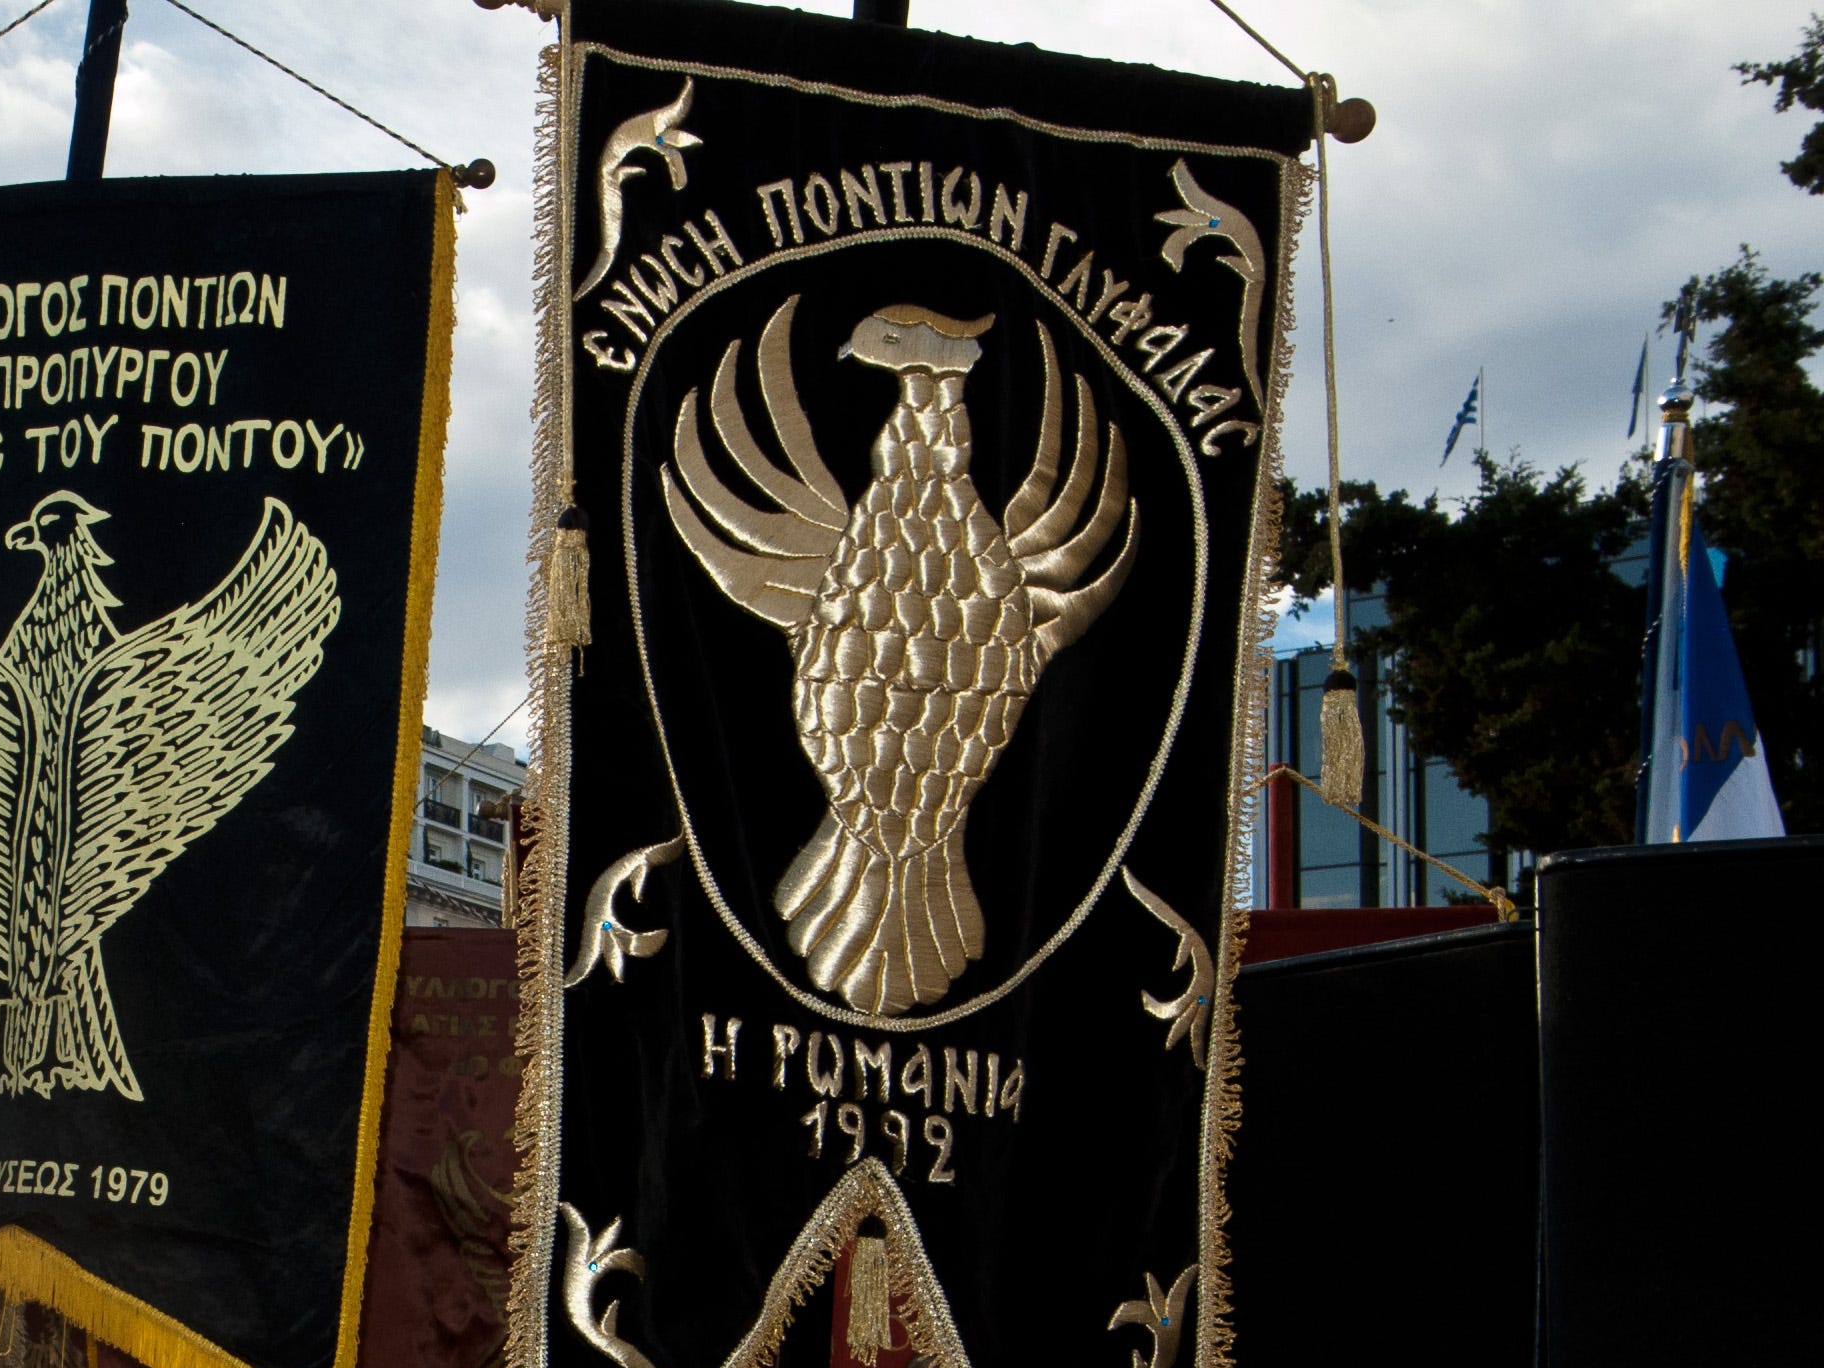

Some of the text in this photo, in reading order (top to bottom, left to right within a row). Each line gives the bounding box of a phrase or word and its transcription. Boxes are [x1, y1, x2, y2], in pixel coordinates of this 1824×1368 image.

[756, 160, 1029, 252] ΠΟΝΤΙΩΝ
[99, 271, 287, 330] ΠΟΝΤΙΩΝ
[25, 414, 119, 474] ΤΟΥ
[701, 1012, 1026, 1123] Η ΡΩΜΑΝΙΑ
[800, 1100, 956, 1185] 1992
[90, 1165, 169, 1207] 1979
